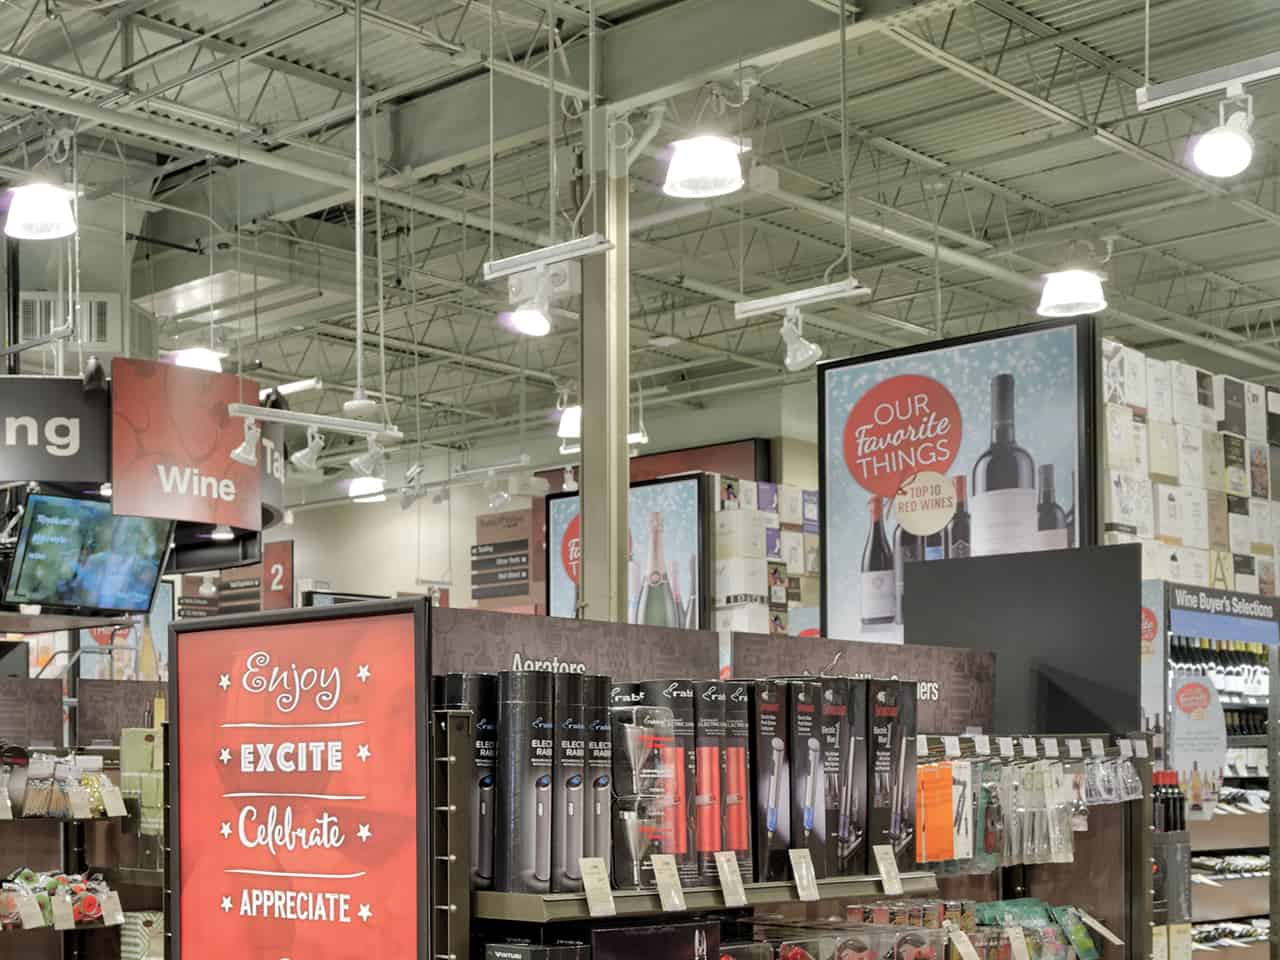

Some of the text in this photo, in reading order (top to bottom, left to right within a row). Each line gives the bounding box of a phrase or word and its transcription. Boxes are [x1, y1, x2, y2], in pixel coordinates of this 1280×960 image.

[873, 393, 931, 425] OUR
[855, 411, 951, 457] Favorite
[856, 439, 951, 480] THINGS
[157, 463, 237, 502] Wine
[909, 485, 929, 498] TOP
[898, 496, 953, 513] RED WINES
[270, 563, 284, 591] 2
[1175, 590, 1273, 618] Wine Buyer's Selections
[242, 650, 341, 713] Enjoy
[240, 741, 342, 773] EXCITE
[238, 805, 346, 855] Celebrate
[239, 888, 351, 923] APPRECIATE
